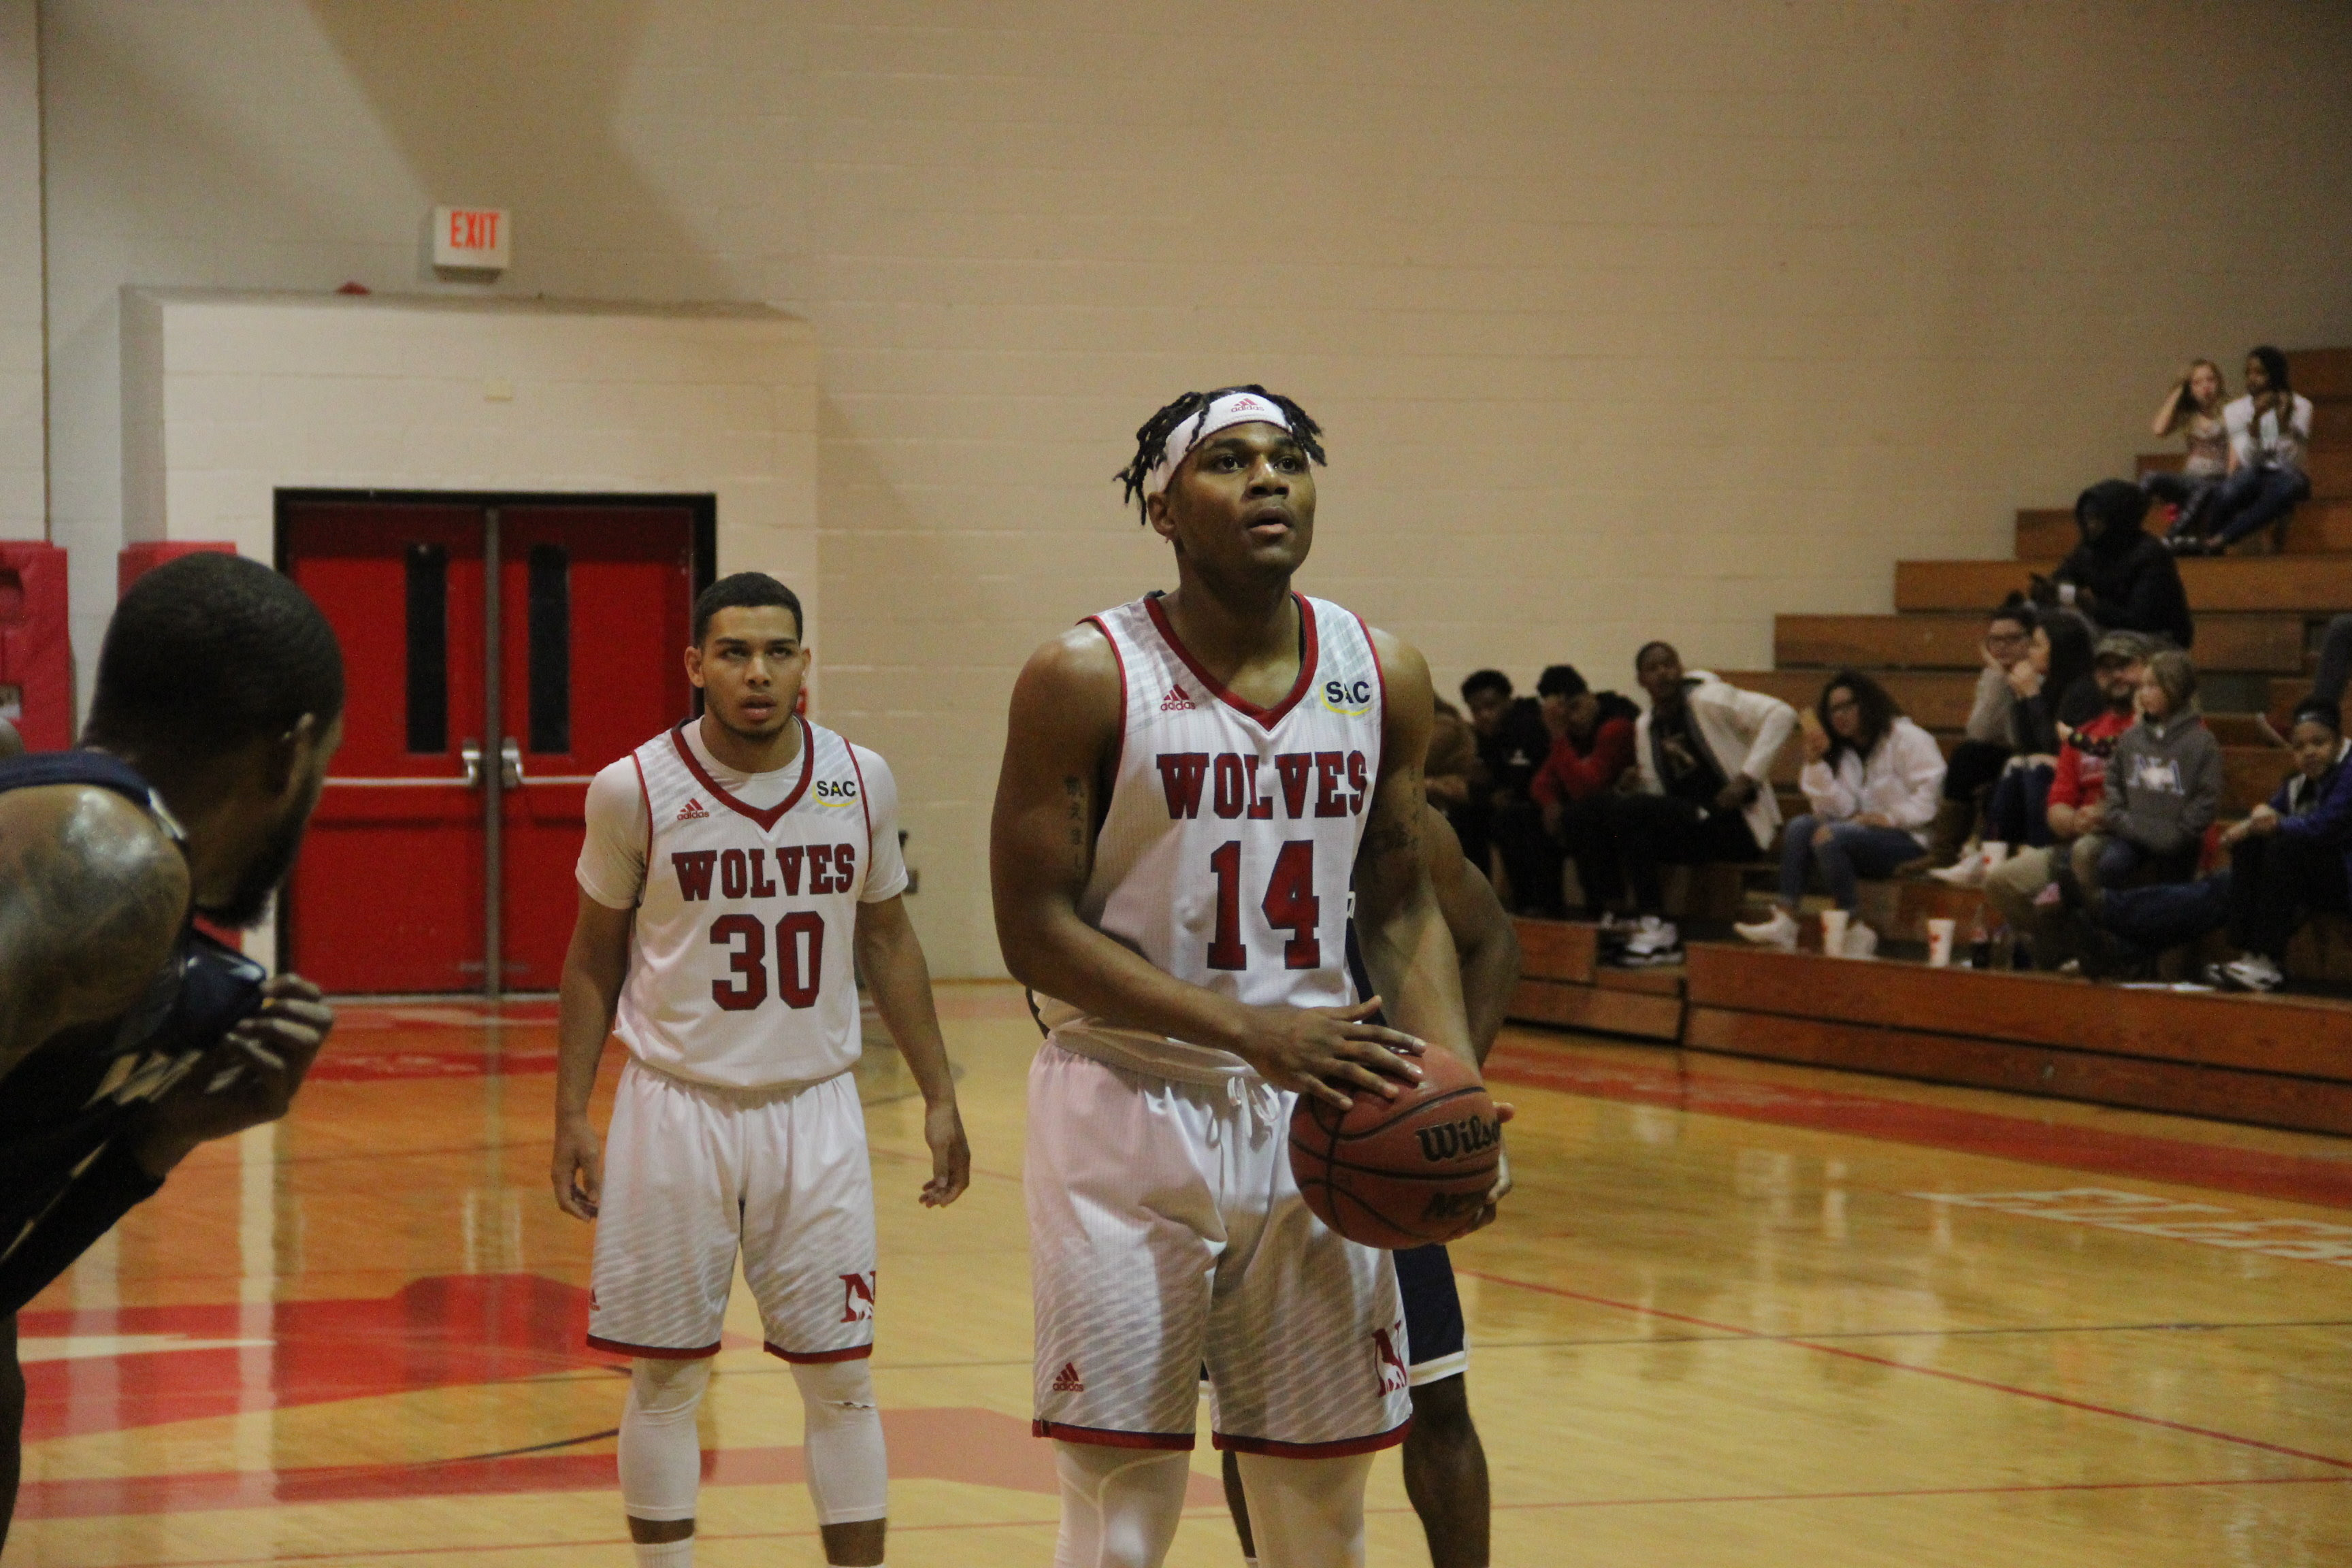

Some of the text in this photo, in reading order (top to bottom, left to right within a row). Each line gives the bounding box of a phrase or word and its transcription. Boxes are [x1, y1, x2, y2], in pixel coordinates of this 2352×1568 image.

[450, 210, 500, 248] EXIT
[1230, 404, 1264, 412] adidas
[1160, 700, 1196, 712] adidas
[817, 781, 857, 798] SAC
[1156, 749, 1368, 820] WOLVES
[676, 809, 710, 821] adidas
[671, 843, 856, 901] WOLVES
[1207, 839, 1320, 971] 14
[709, 910, 826, 1011] 30
[1415, 1115, 1501, 1162] Wilso
[1052, 1380, 1084, 1392] adidas
